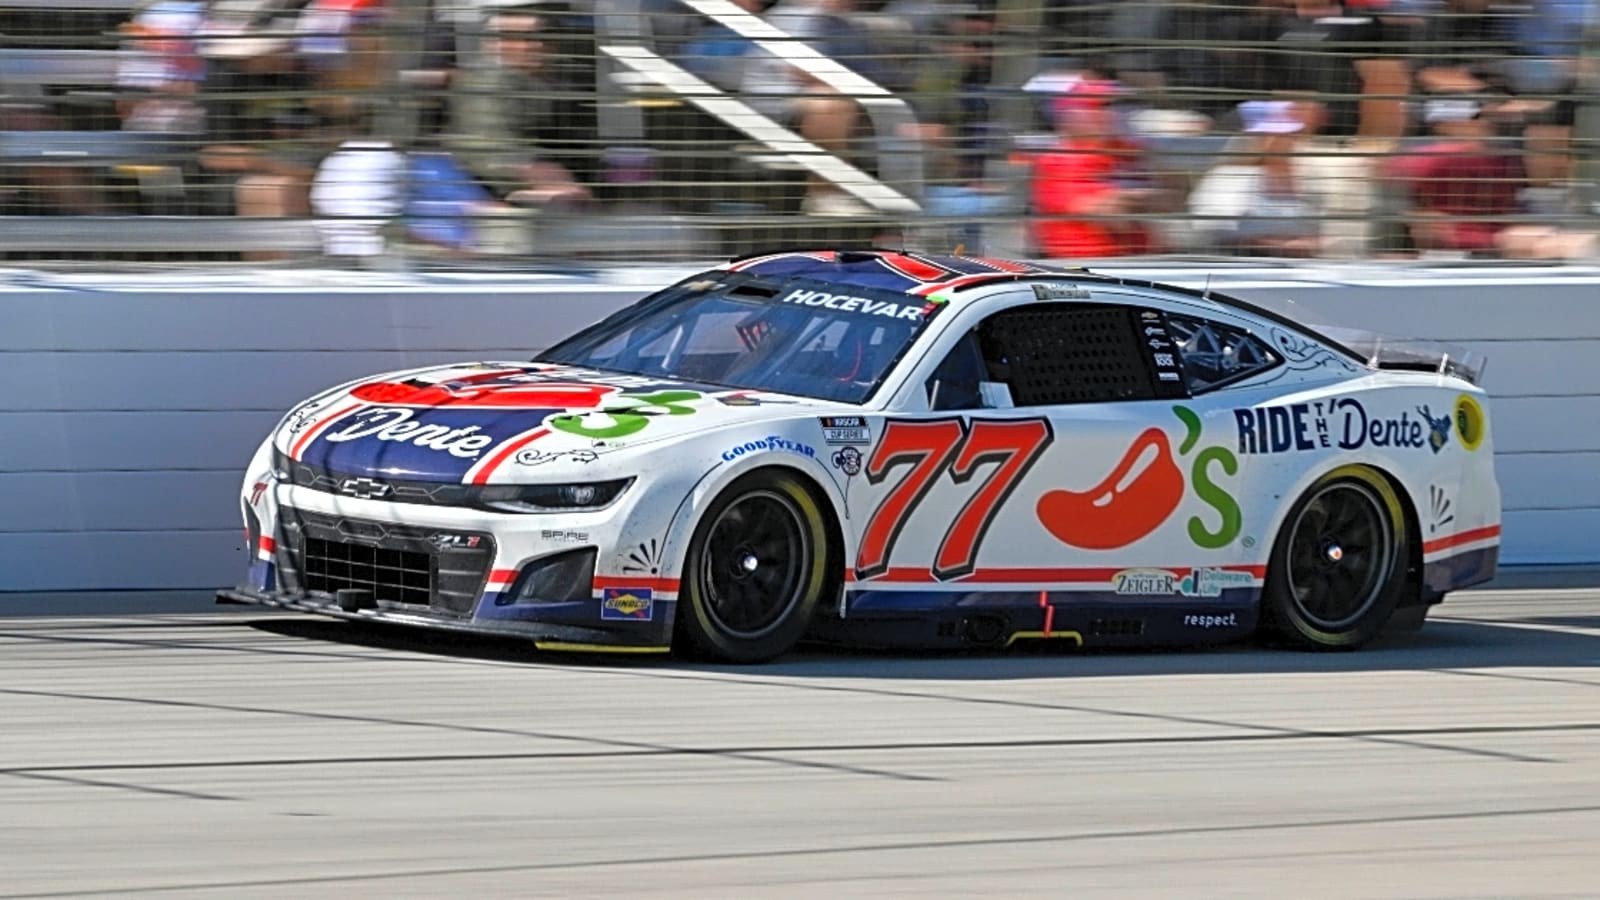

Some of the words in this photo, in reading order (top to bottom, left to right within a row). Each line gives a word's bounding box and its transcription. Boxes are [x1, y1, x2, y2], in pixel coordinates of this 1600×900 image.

[782, 288, 924, 321] HOCEVAR
[834, 417, 860, 427] NASCAR
[1233, 403, 1316, 454] RIDE
[1313, 402, 1332, 448] THE
[721, 435, 816, 462] GOODYEAR
[853, 415, 1056, 582] 77
[1117, 574, 1175, 593] ZEIGLER
[1203, 569, 1252, 582] Delaware
[1202, 584, 1221, 595] Life
[606, 599, 651, 609] SUNOCO
[1184, 613, 1238, 628] respect.
